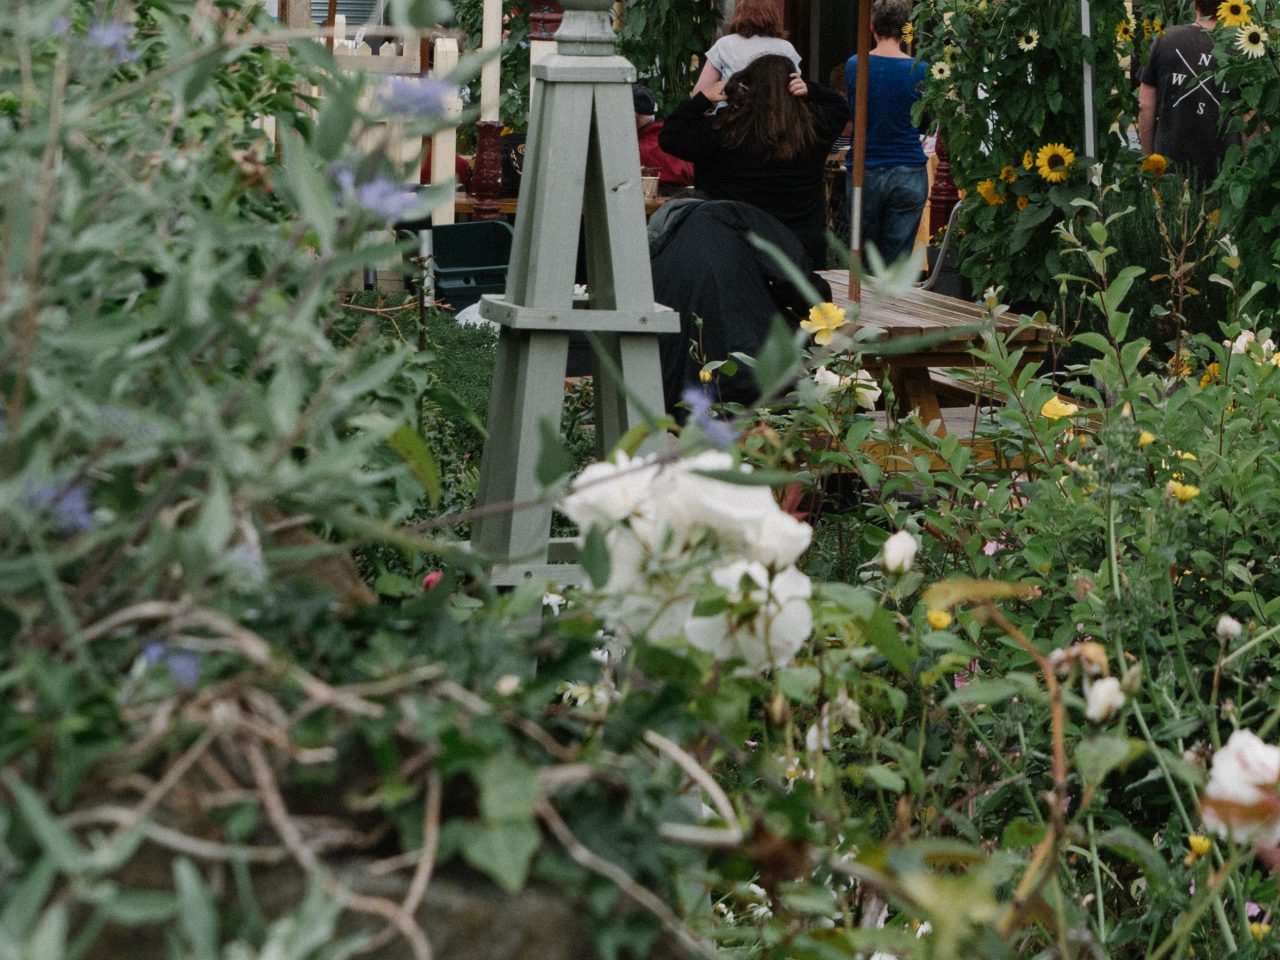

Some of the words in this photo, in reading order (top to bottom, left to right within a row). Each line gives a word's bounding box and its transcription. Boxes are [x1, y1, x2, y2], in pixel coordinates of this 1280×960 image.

[1197, 53, 1213, 67] N
[1171, 72, 1187, 86] W
[1196, 102, 1206, 115] S
